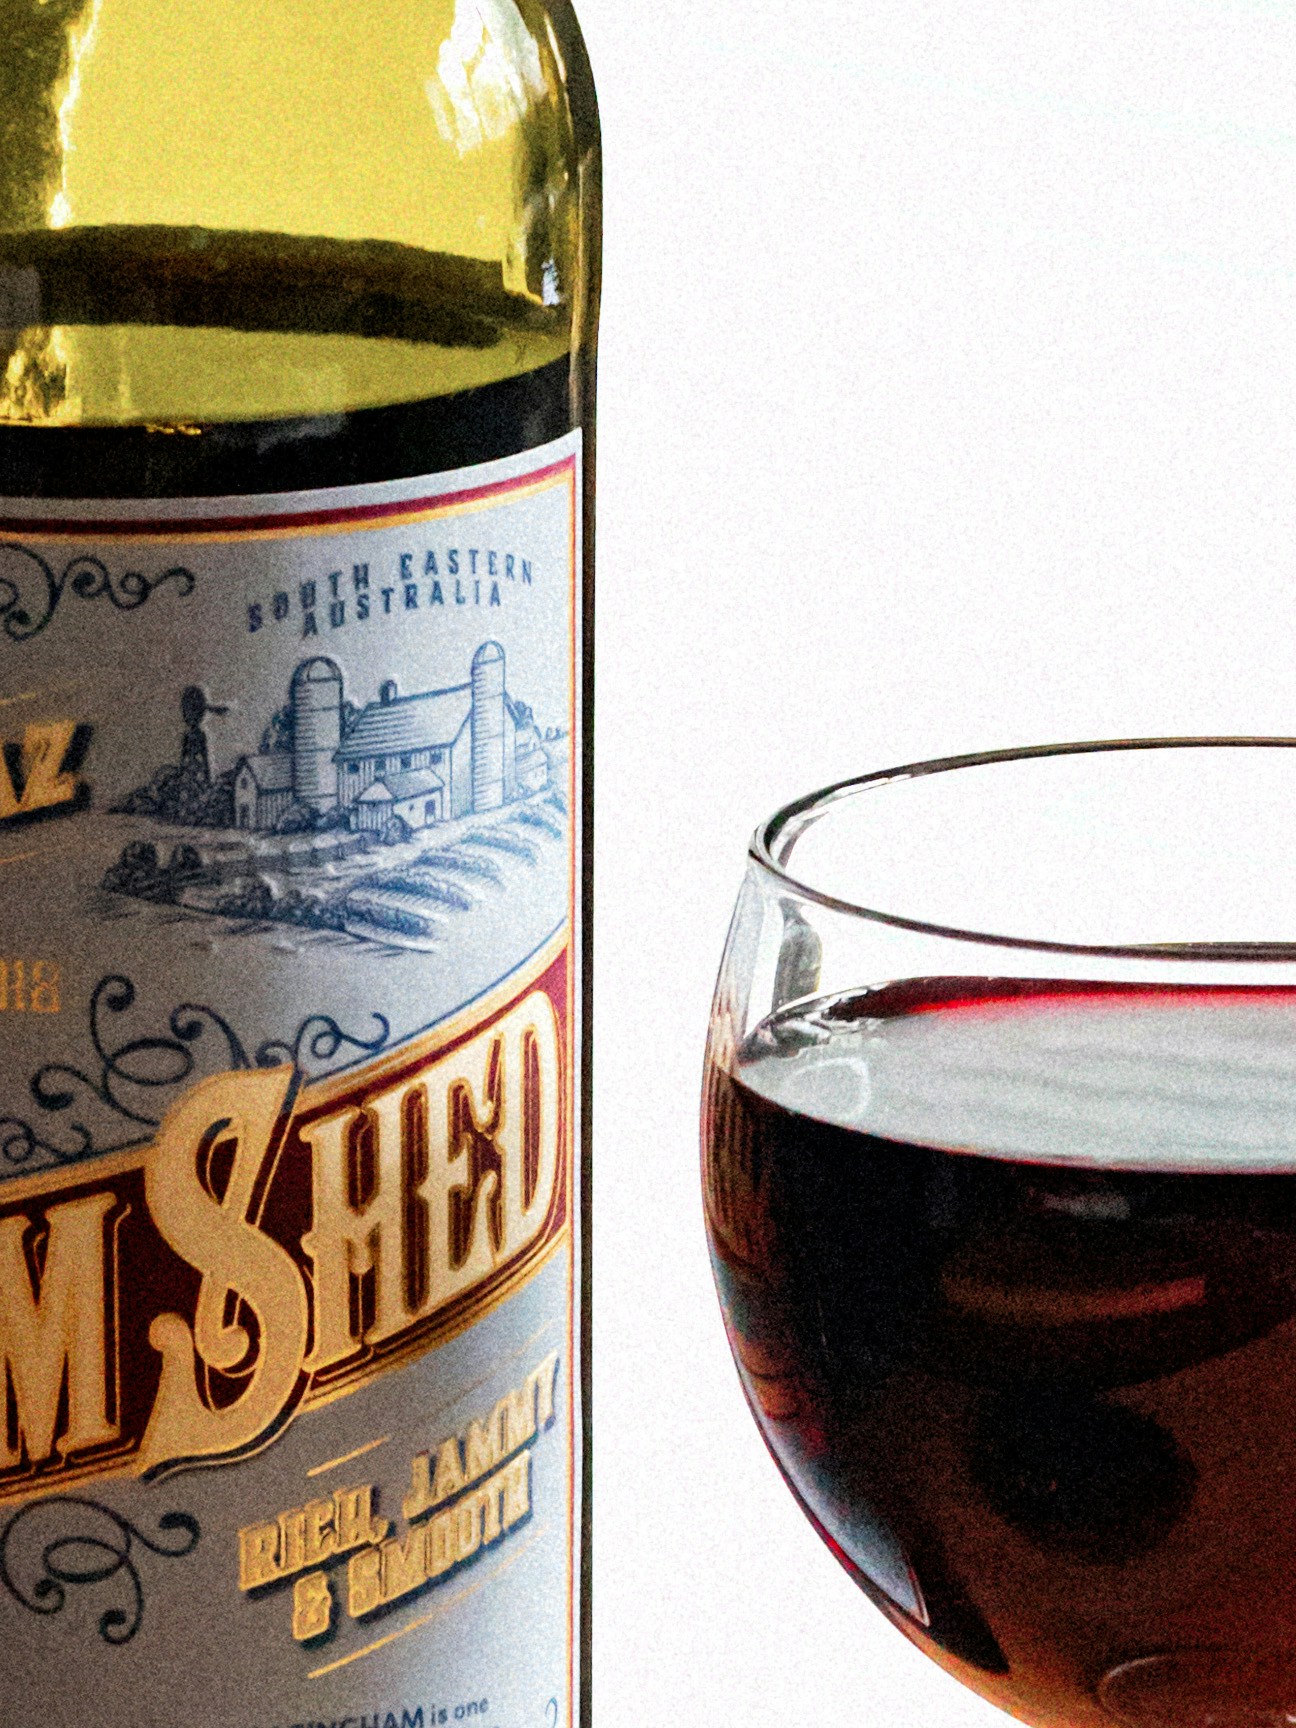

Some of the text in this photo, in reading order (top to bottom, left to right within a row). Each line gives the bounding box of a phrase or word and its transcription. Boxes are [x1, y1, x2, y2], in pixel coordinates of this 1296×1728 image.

[246, 548, 533, 634] SOUTH EASTERN
[303, 579, 502, 638] AUSTRALIA
[134, 987, 561, 1478] SHED
[238, 1349, 561, 1592] RICH, JAMMY
[292, 1449, 531, 1640] & SMOOTH
[430, 1702, 449, 1728] is
[453, 1697, 489, 1721] one
